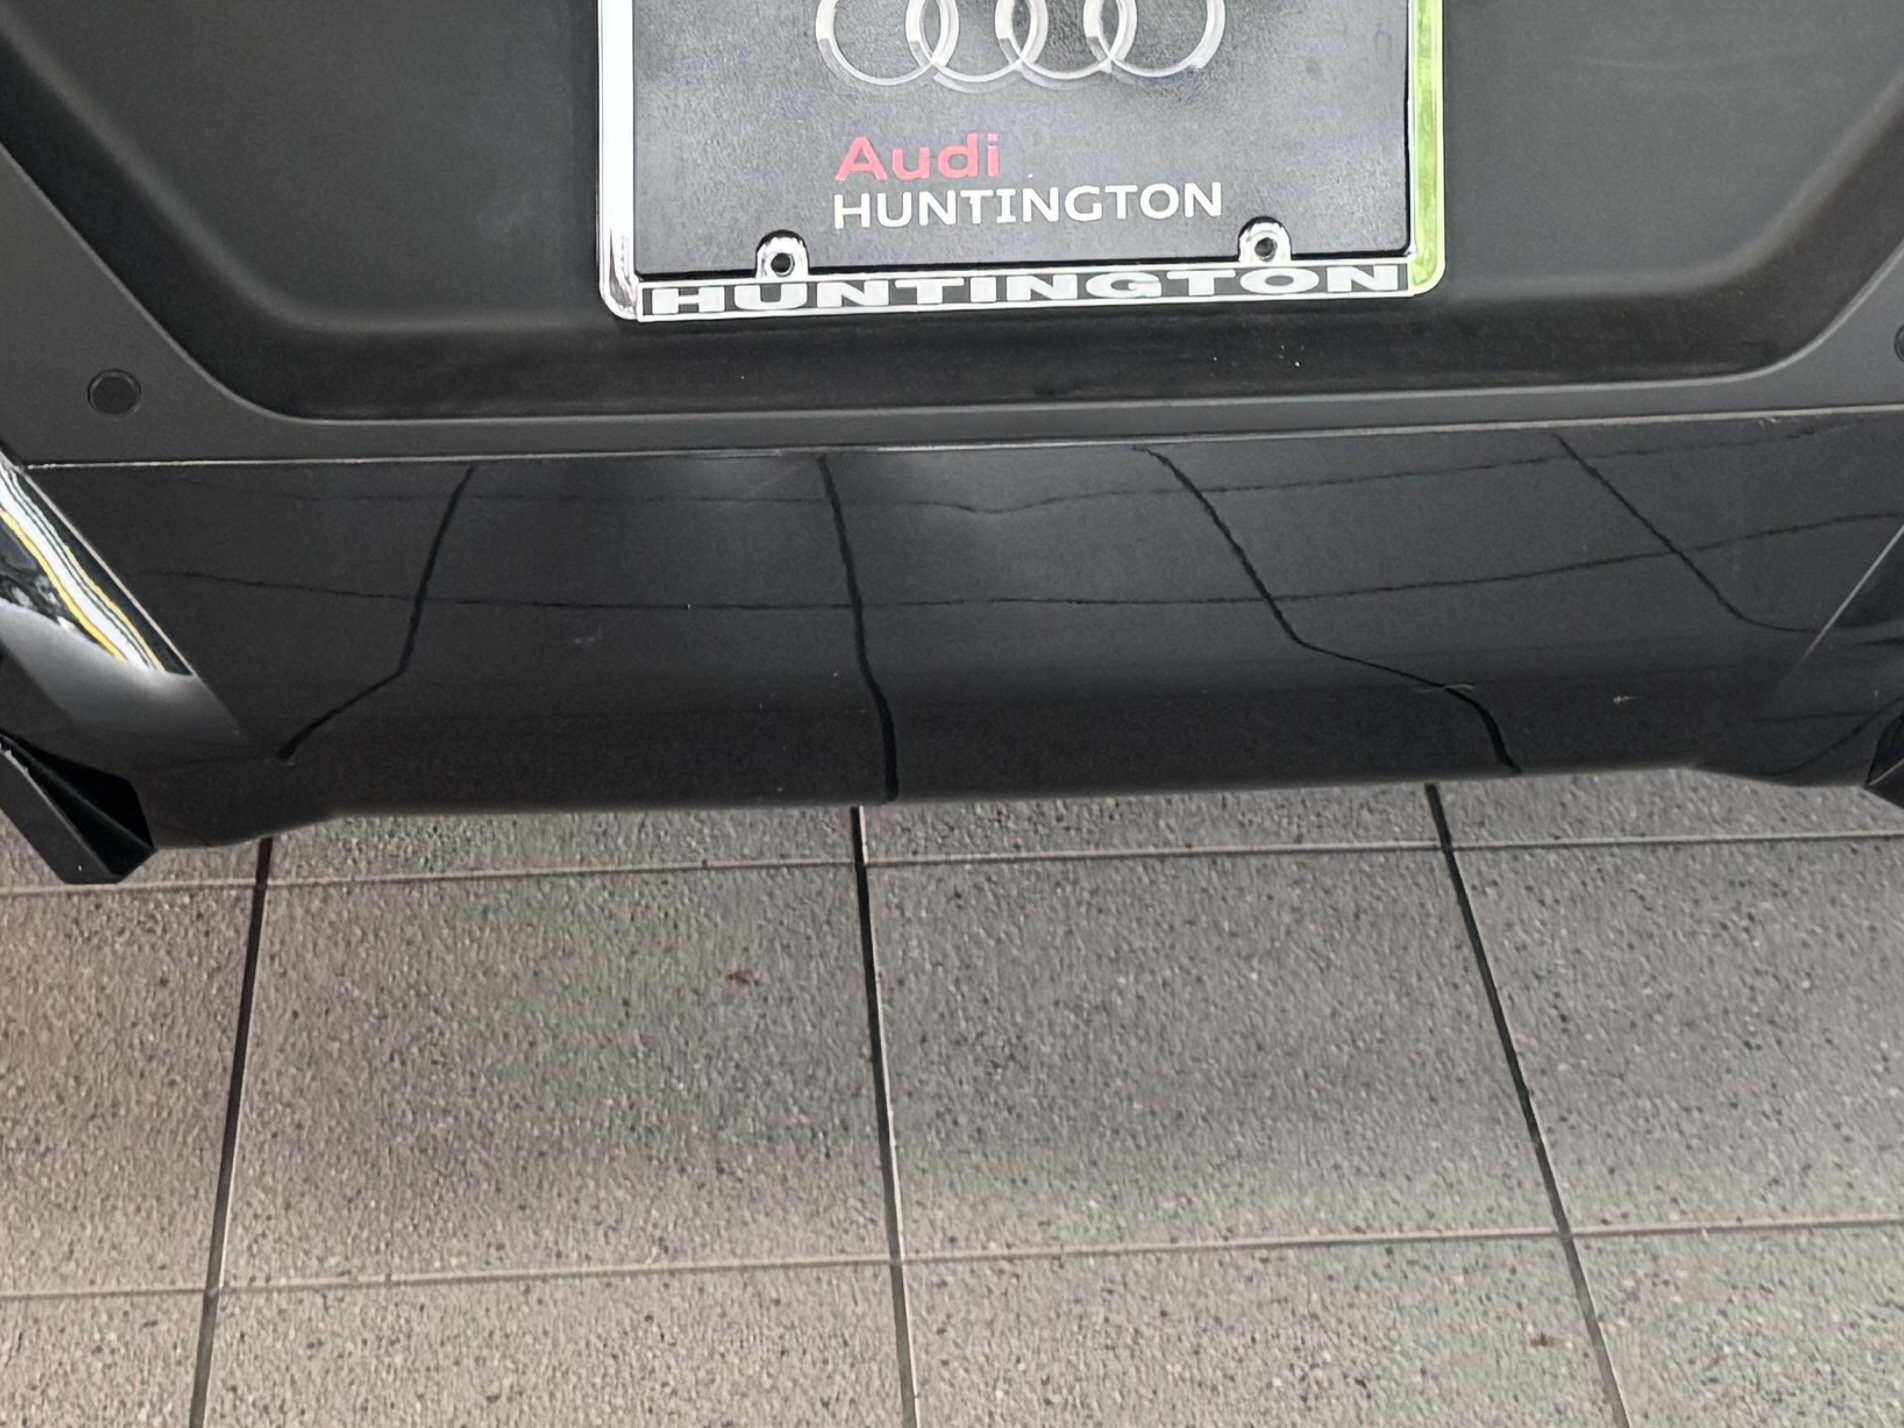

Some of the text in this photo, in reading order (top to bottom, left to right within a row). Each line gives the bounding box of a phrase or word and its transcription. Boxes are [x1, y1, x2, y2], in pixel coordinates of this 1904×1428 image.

[835, 132, 1001, 182] Audi
[833, 181, 1223, 230] HUNTINGTON
[651, 263, 1399, 316] HUNTINGTON
